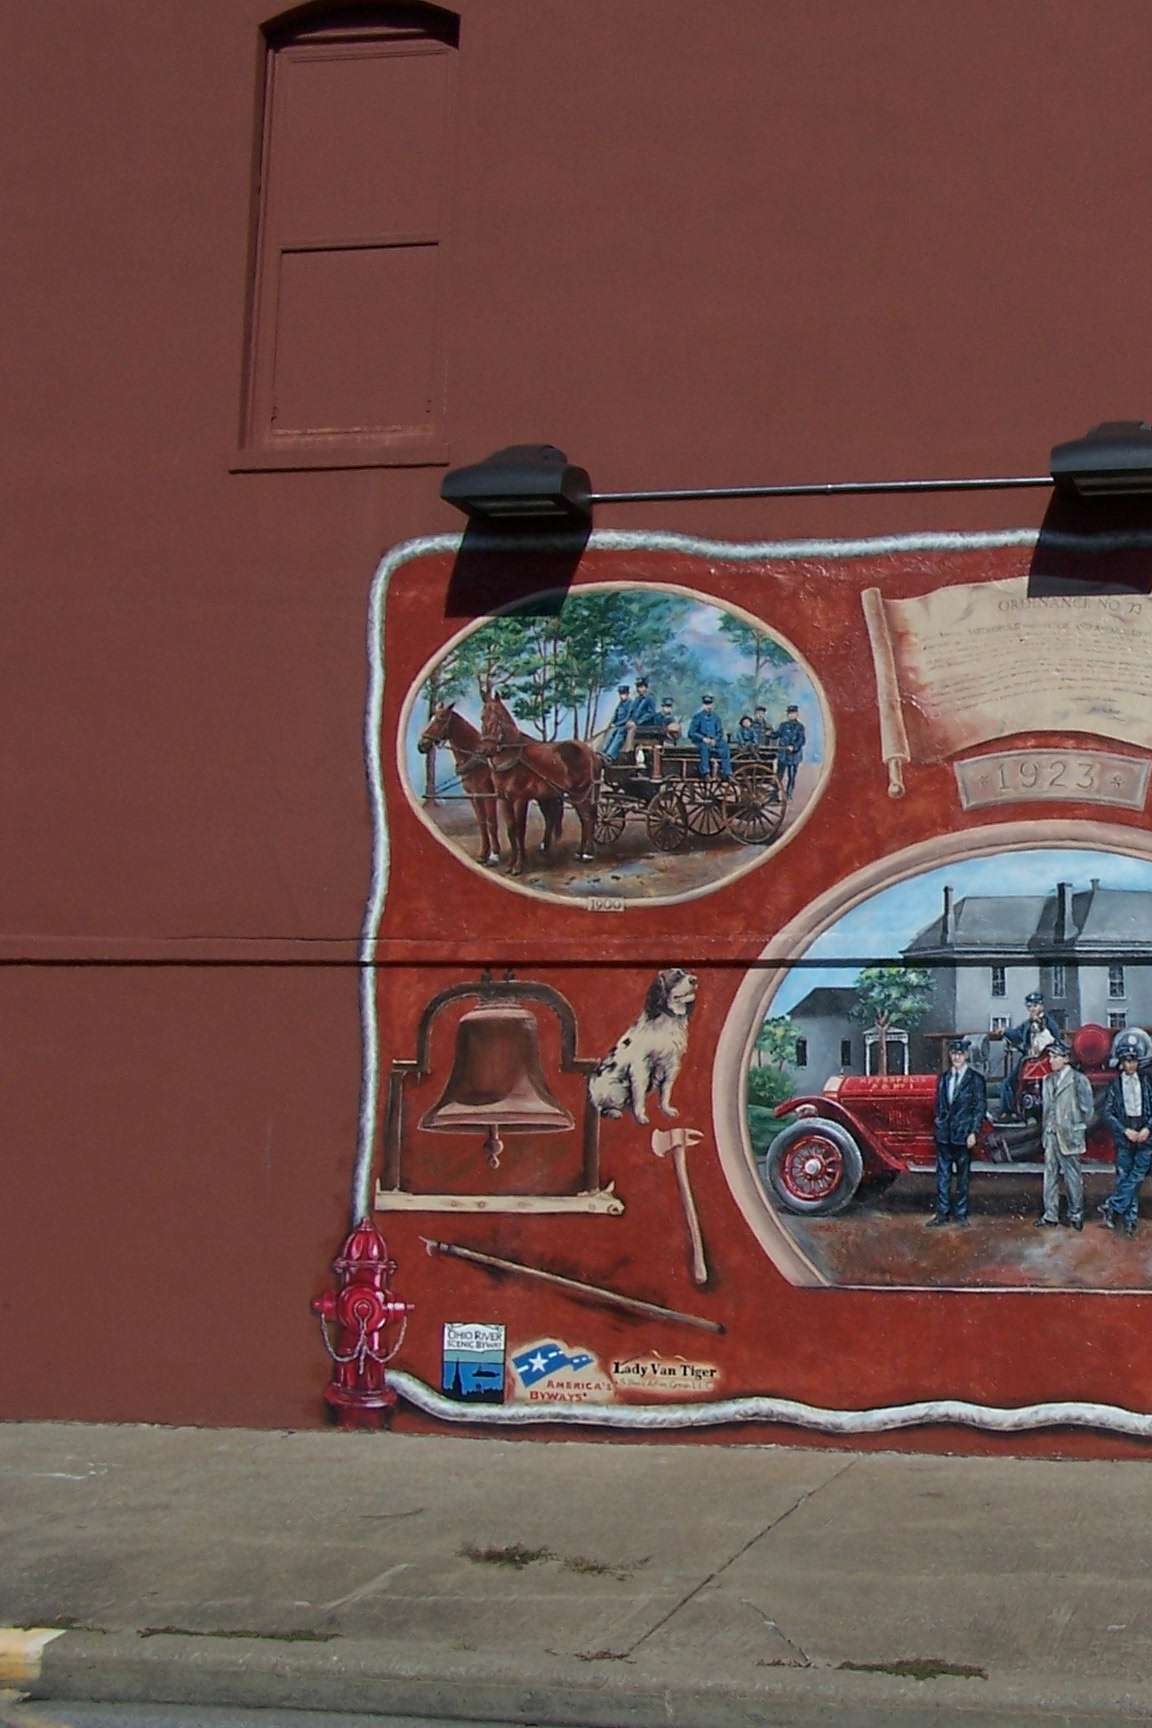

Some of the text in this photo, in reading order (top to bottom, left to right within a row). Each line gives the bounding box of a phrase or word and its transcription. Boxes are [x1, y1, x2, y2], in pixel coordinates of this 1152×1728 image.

[998, 760, 1095, 790] 1923
[447, 1329, 503, 1342] OHIO RIVER
[446, 1340, 475, 1349] SCENIC
[613, 1361, 718, 1381] Lady Van Tiger
[546, 1379, 613, 1392] AMERICA'S
